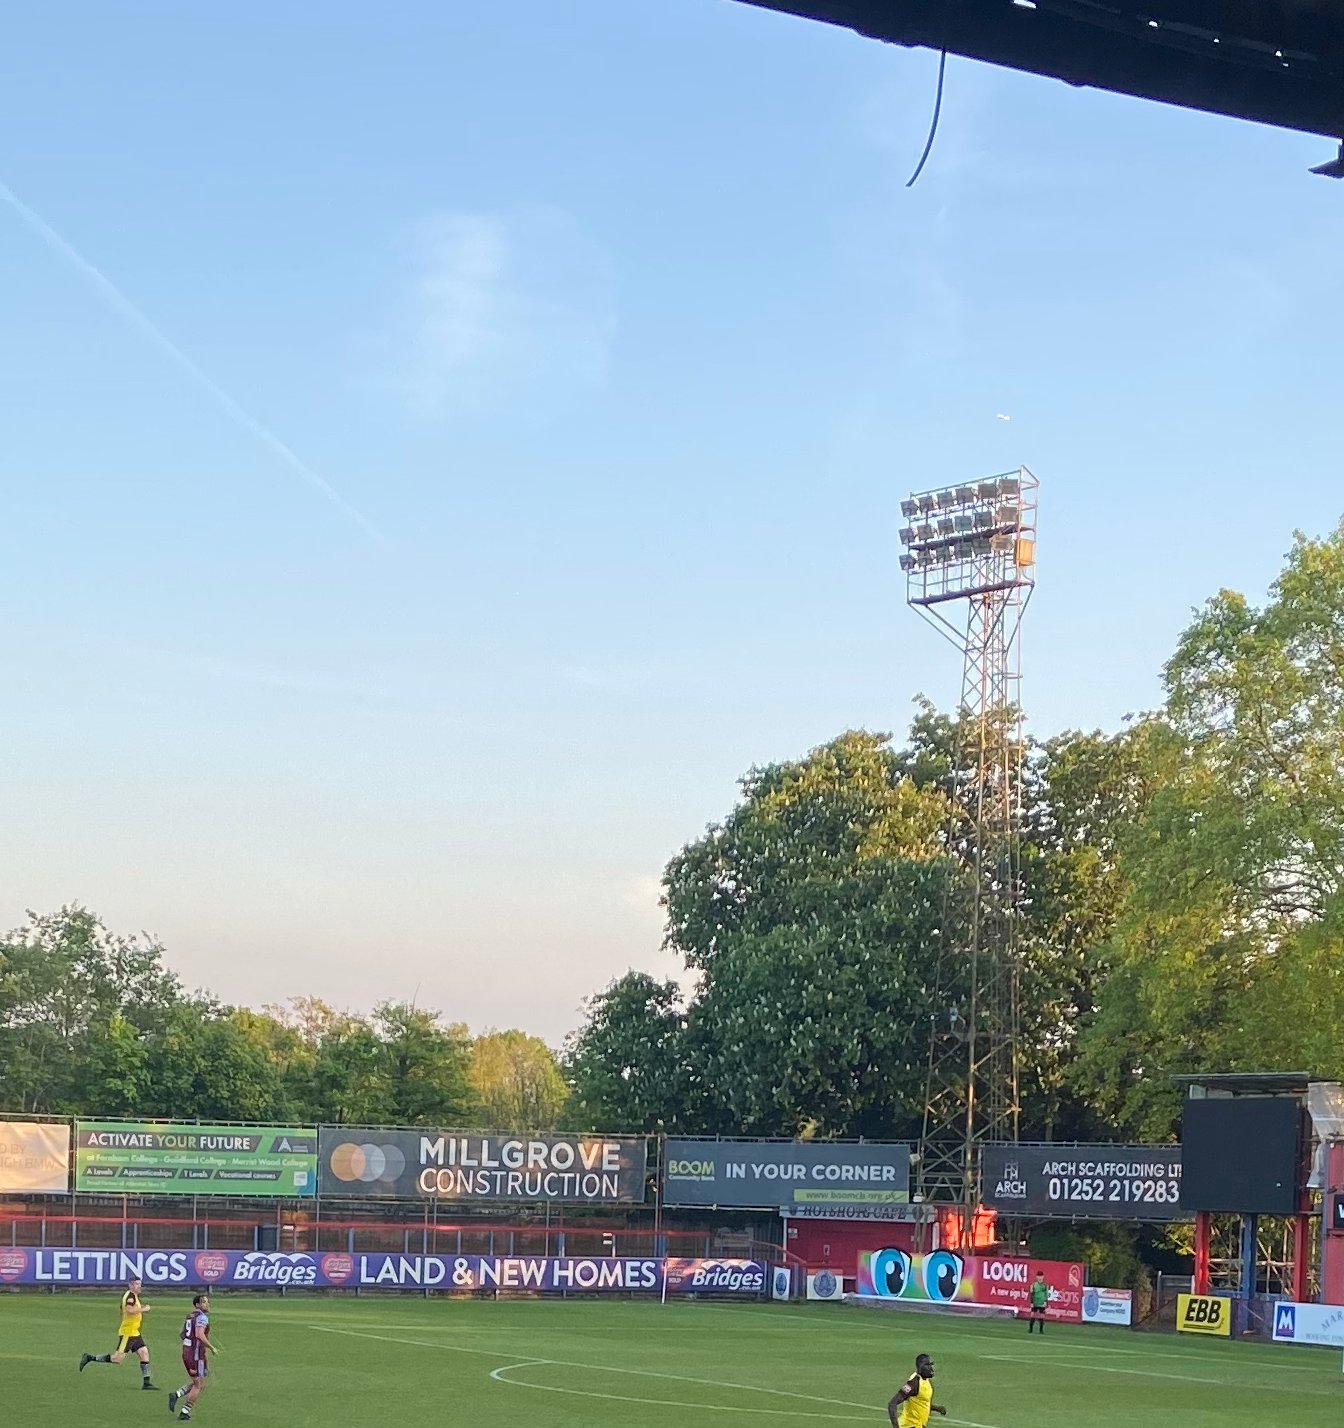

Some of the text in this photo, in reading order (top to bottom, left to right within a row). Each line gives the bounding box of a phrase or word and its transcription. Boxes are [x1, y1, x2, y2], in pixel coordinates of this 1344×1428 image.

[87, 1132, 250, 1150] ACTIVATE YOUR FUTURE
[420, 1137, 620, 1171] MILLGROVE
[669, 1160, 715, 1175] BOOM
[726, 1163, 896, 1181] IN YOUR CORNER
[1042, 1162, 1182, 1178] ARCH SCAFFOLDING LT
[419, 1168, 618, 1198] CONSTRUCTION
[995, 1180, 1027, 1194] ARCH
[1049, 1178, 1180, 1203] 01252 219283
[35, 1251, 187, 1281] LETTINGS
[234, 1260, 316, 1284] Bridges
[360, 1256, 656, 1287] LAND & NEW HOMES
[982, 1261, 1027, 1283] LOOK!
[692, 1267, 763, 1290] Bridges
[990, 1285, 1029, 1300] A new sign by
[1185, 1299, 1222, 1324] EBB
